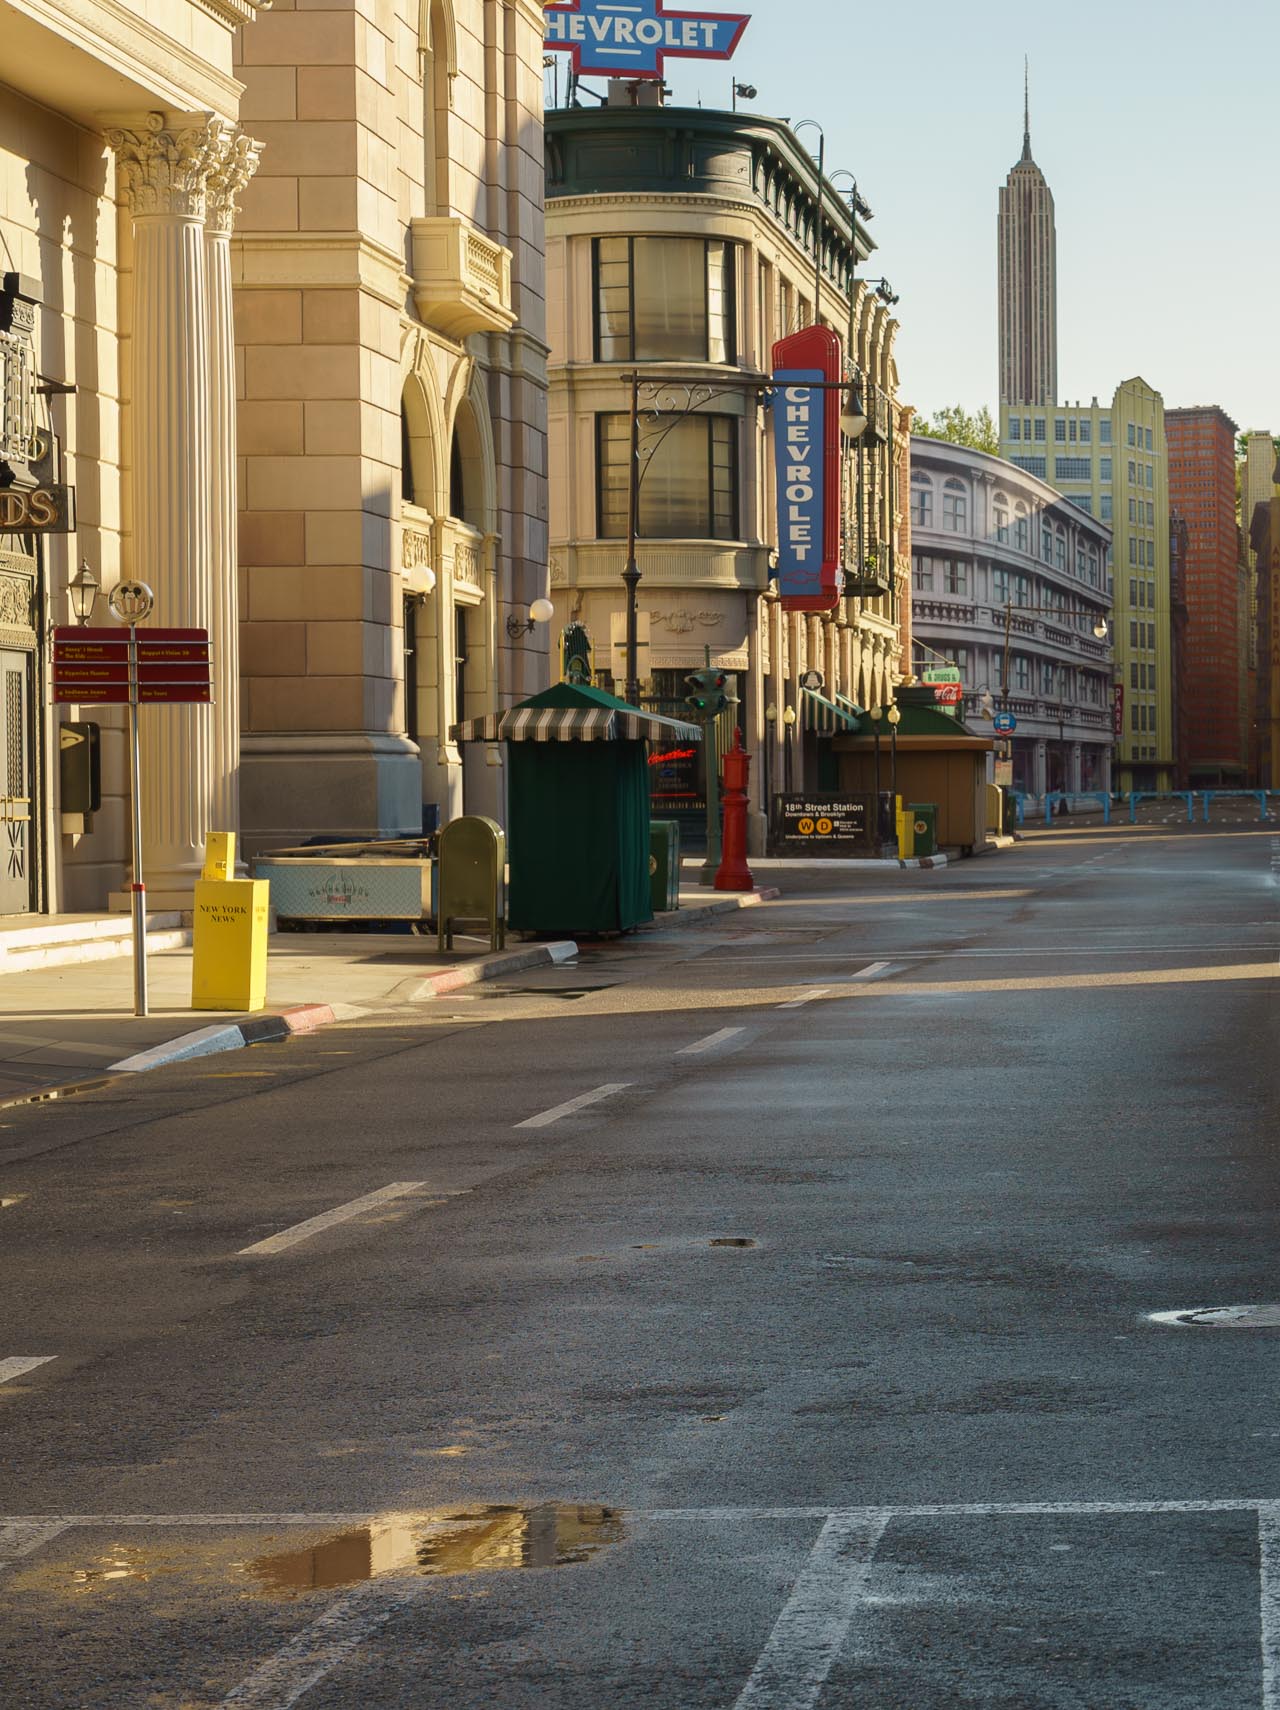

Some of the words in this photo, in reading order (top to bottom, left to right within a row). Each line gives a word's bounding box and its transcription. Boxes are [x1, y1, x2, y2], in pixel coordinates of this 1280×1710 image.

[785, 386, 815, 561] CHEVROLET
[785, 803, 803, 811] 18th
[805, 803, 831, 811] Street
[832, 803, 864, 811] Station
[801, 821, 812, 831] W
[820, 821, 829, 831] D
[200, 904, 218, 913] NEW
[222, 905, 247, 914] YORK
[211, 914, 235, 922] NEWS
